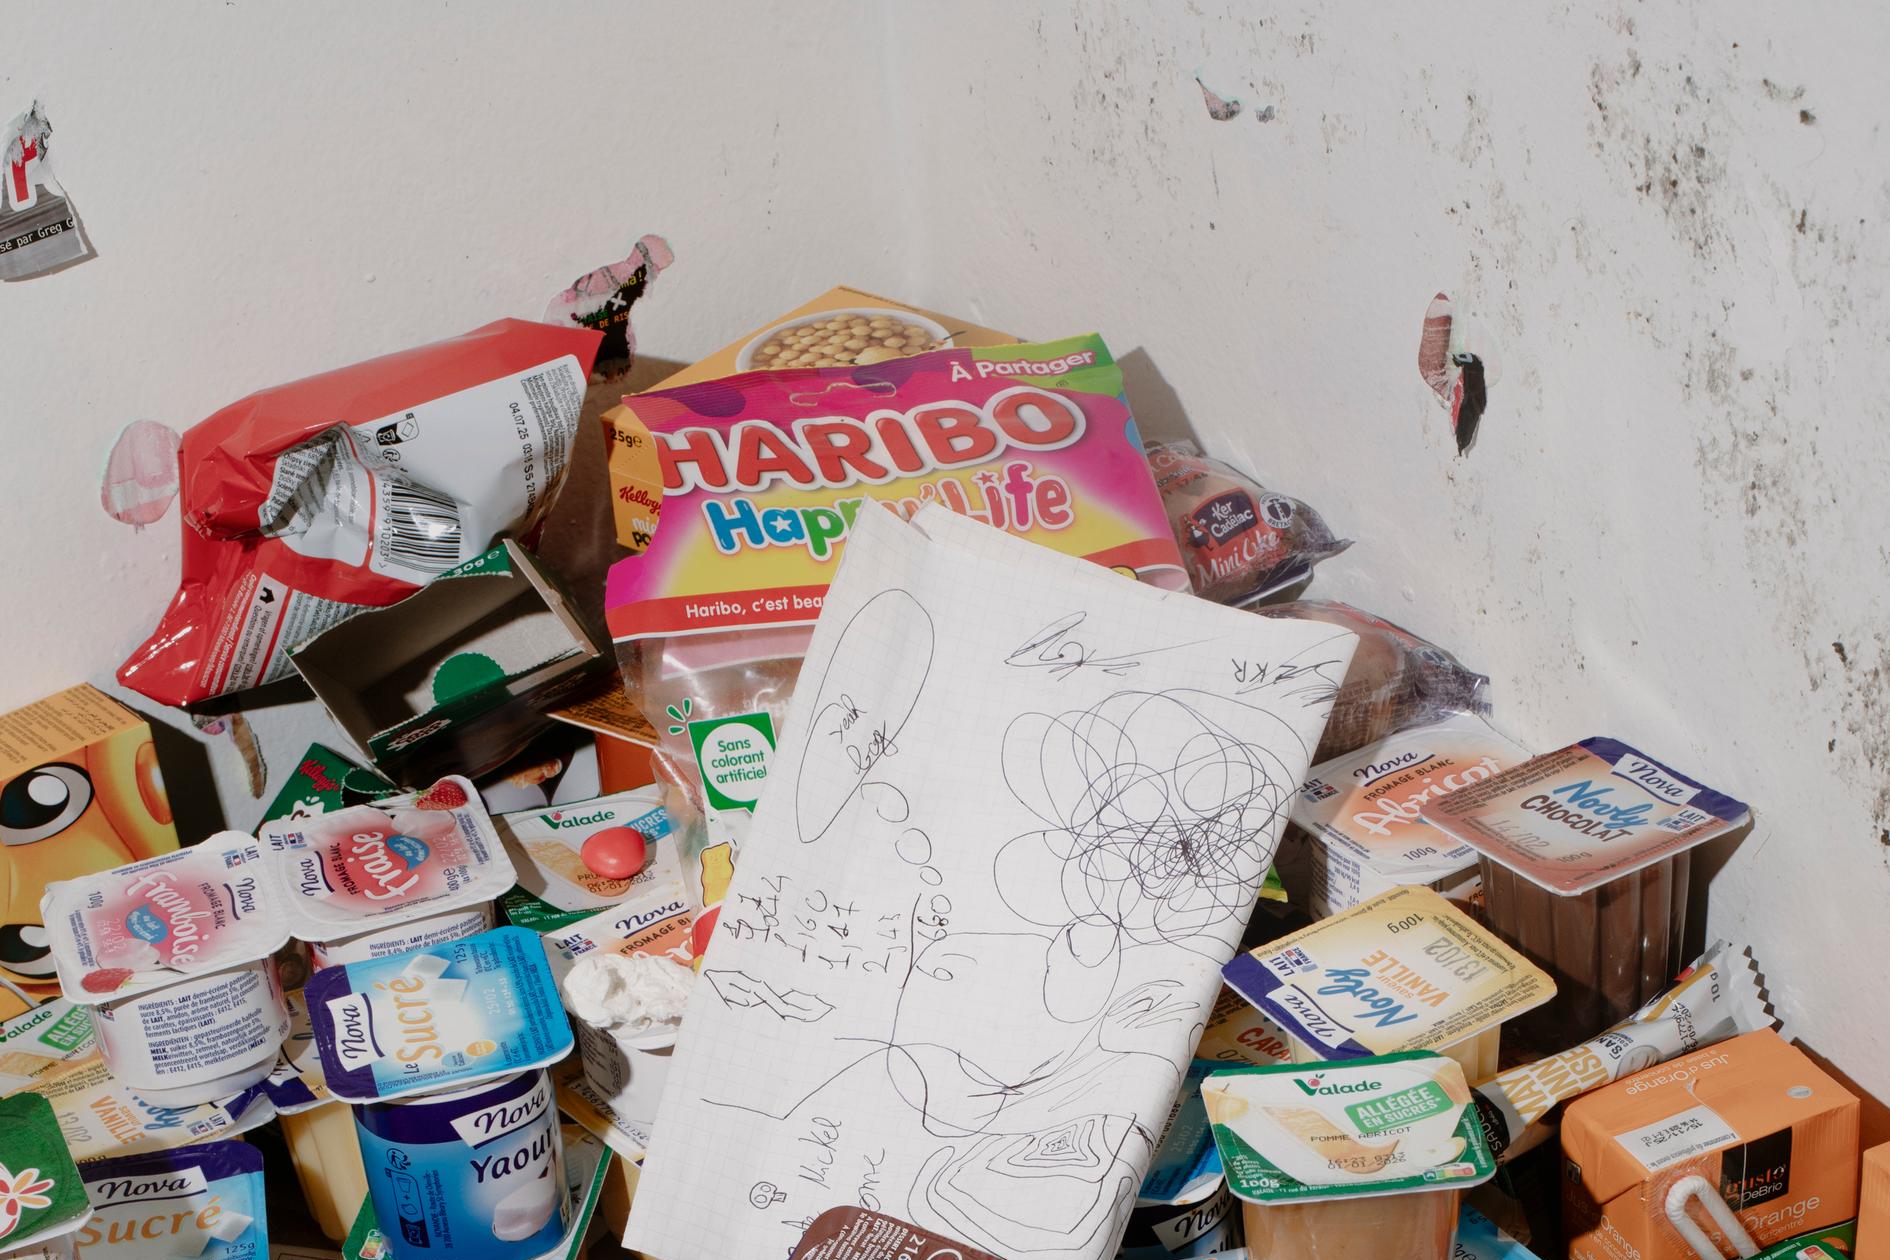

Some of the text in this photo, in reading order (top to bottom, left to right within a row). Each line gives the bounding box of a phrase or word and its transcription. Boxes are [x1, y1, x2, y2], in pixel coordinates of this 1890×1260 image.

[17, 222, 63, 248] par Greg
[950, 350, 1095, 383] À Partager
[508, 402, 529, 440] 04.07.25
[651, 387, 1085, 496] HARIBO
[1210, 508, 1254, 538] Cadélac
[1211, 500, 1233, 521] Ker
[1197, 529, 1280, 588] Mini Cake
[685, 597, 788, 619] Haribo, c'est
[717, 738, 751, 753] Sans
[711, 751, 765, 769] colorant
[1353, 752, 1418, 780] Nova
[716, 766, 768, 785] artificiel
[1364, 774, 1412, 802] FROMAGE
[1414, 759, 1454, 780] BLANC
[1631, 759, 1683, 798] Nova
[1353, 756, 1502, 835] Abricot
[539, 809, 615, 830] Valade
[1520, 795, 1632, 843] CHOCOLAT
[1677, 809, 1706, 824] LAIT
[245, 845, 260, 861] LAIT
[270, 834, 285, 851] LAIT
[1402, 847, 1437, 861] 100g
[300, 858, 323, 897] Nova
[335, 865, 360, 896] FROMAGE
[200, 882, 226, 930] FROMAGE BLANC
[241, 877, 256, 914] Nova
[615, 902, 684, 931] Nova
[1387, 911, 1425, 935] 100g
[410, 934, 423, 944] LAIT
[555, 934, 583, 950] LAIT
[620, 924, 668, 955] FROMAGE
[457, 943, 470, 965] 125g
[1268, 958, 1294, 977] LAIT
[1361, 950, 1450, 1009] VANILLE
[178, 995, 191, 1004] LAIT
[373, 975, 442, 1060] Sucré
[1284, 994, 1334, 1038] Nova
[61, 1031, 77, 1046] EN
[343, 1003, 360, 1060] Nova
[404, 1062, 420, 1076] Le
[1704, 1053, 1730, 1070] Jus
[1293, 1076, 1382, 1097] Valade
[474, 1087, 546, 1134] Nova
[1356, 1085, 1432, 1120] ALLÉGÉE
[89, 1095, 145, 1145] VANILLE
[1363, 1115, 1381, 1130] EN
[1310, 1126, 1411, 1143] POMME ABRICOT
[98, 1173, 193, 1199] Nova
[1240, 1178, 1280, 1188] 100g
[1741, 1181, 1784, 1202] DeBrio
[76, 1197, 222, 1248] Sucré
[225, 1243, 256, 1254] 125g
